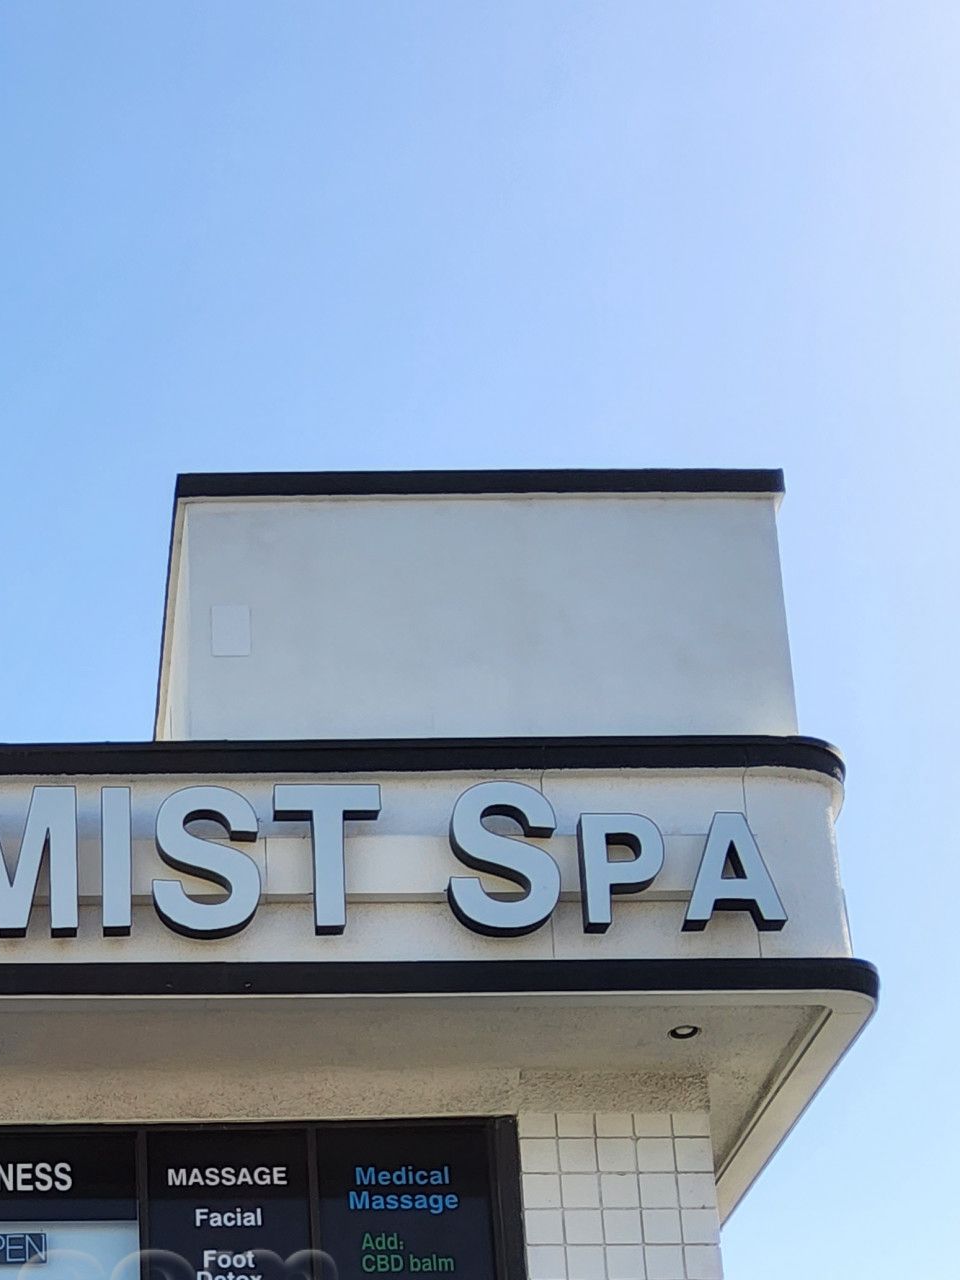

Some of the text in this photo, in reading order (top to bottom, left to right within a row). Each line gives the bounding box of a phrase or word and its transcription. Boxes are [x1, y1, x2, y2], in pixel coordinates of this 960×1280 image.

[446, 780, 788, 937] SPA
[167, 1166, 288, 1186] MASSAGE
[355, 1165, 450, 1186] Medical
[348, 1191, 459, 1214] Massage
[195, 1207, 262, 1227] Facial
[362, 1232, 404, 1251] Add:
[203, 1249, 255, 1269] Foot
[361, 1254, 455, 1273] CBD balm
